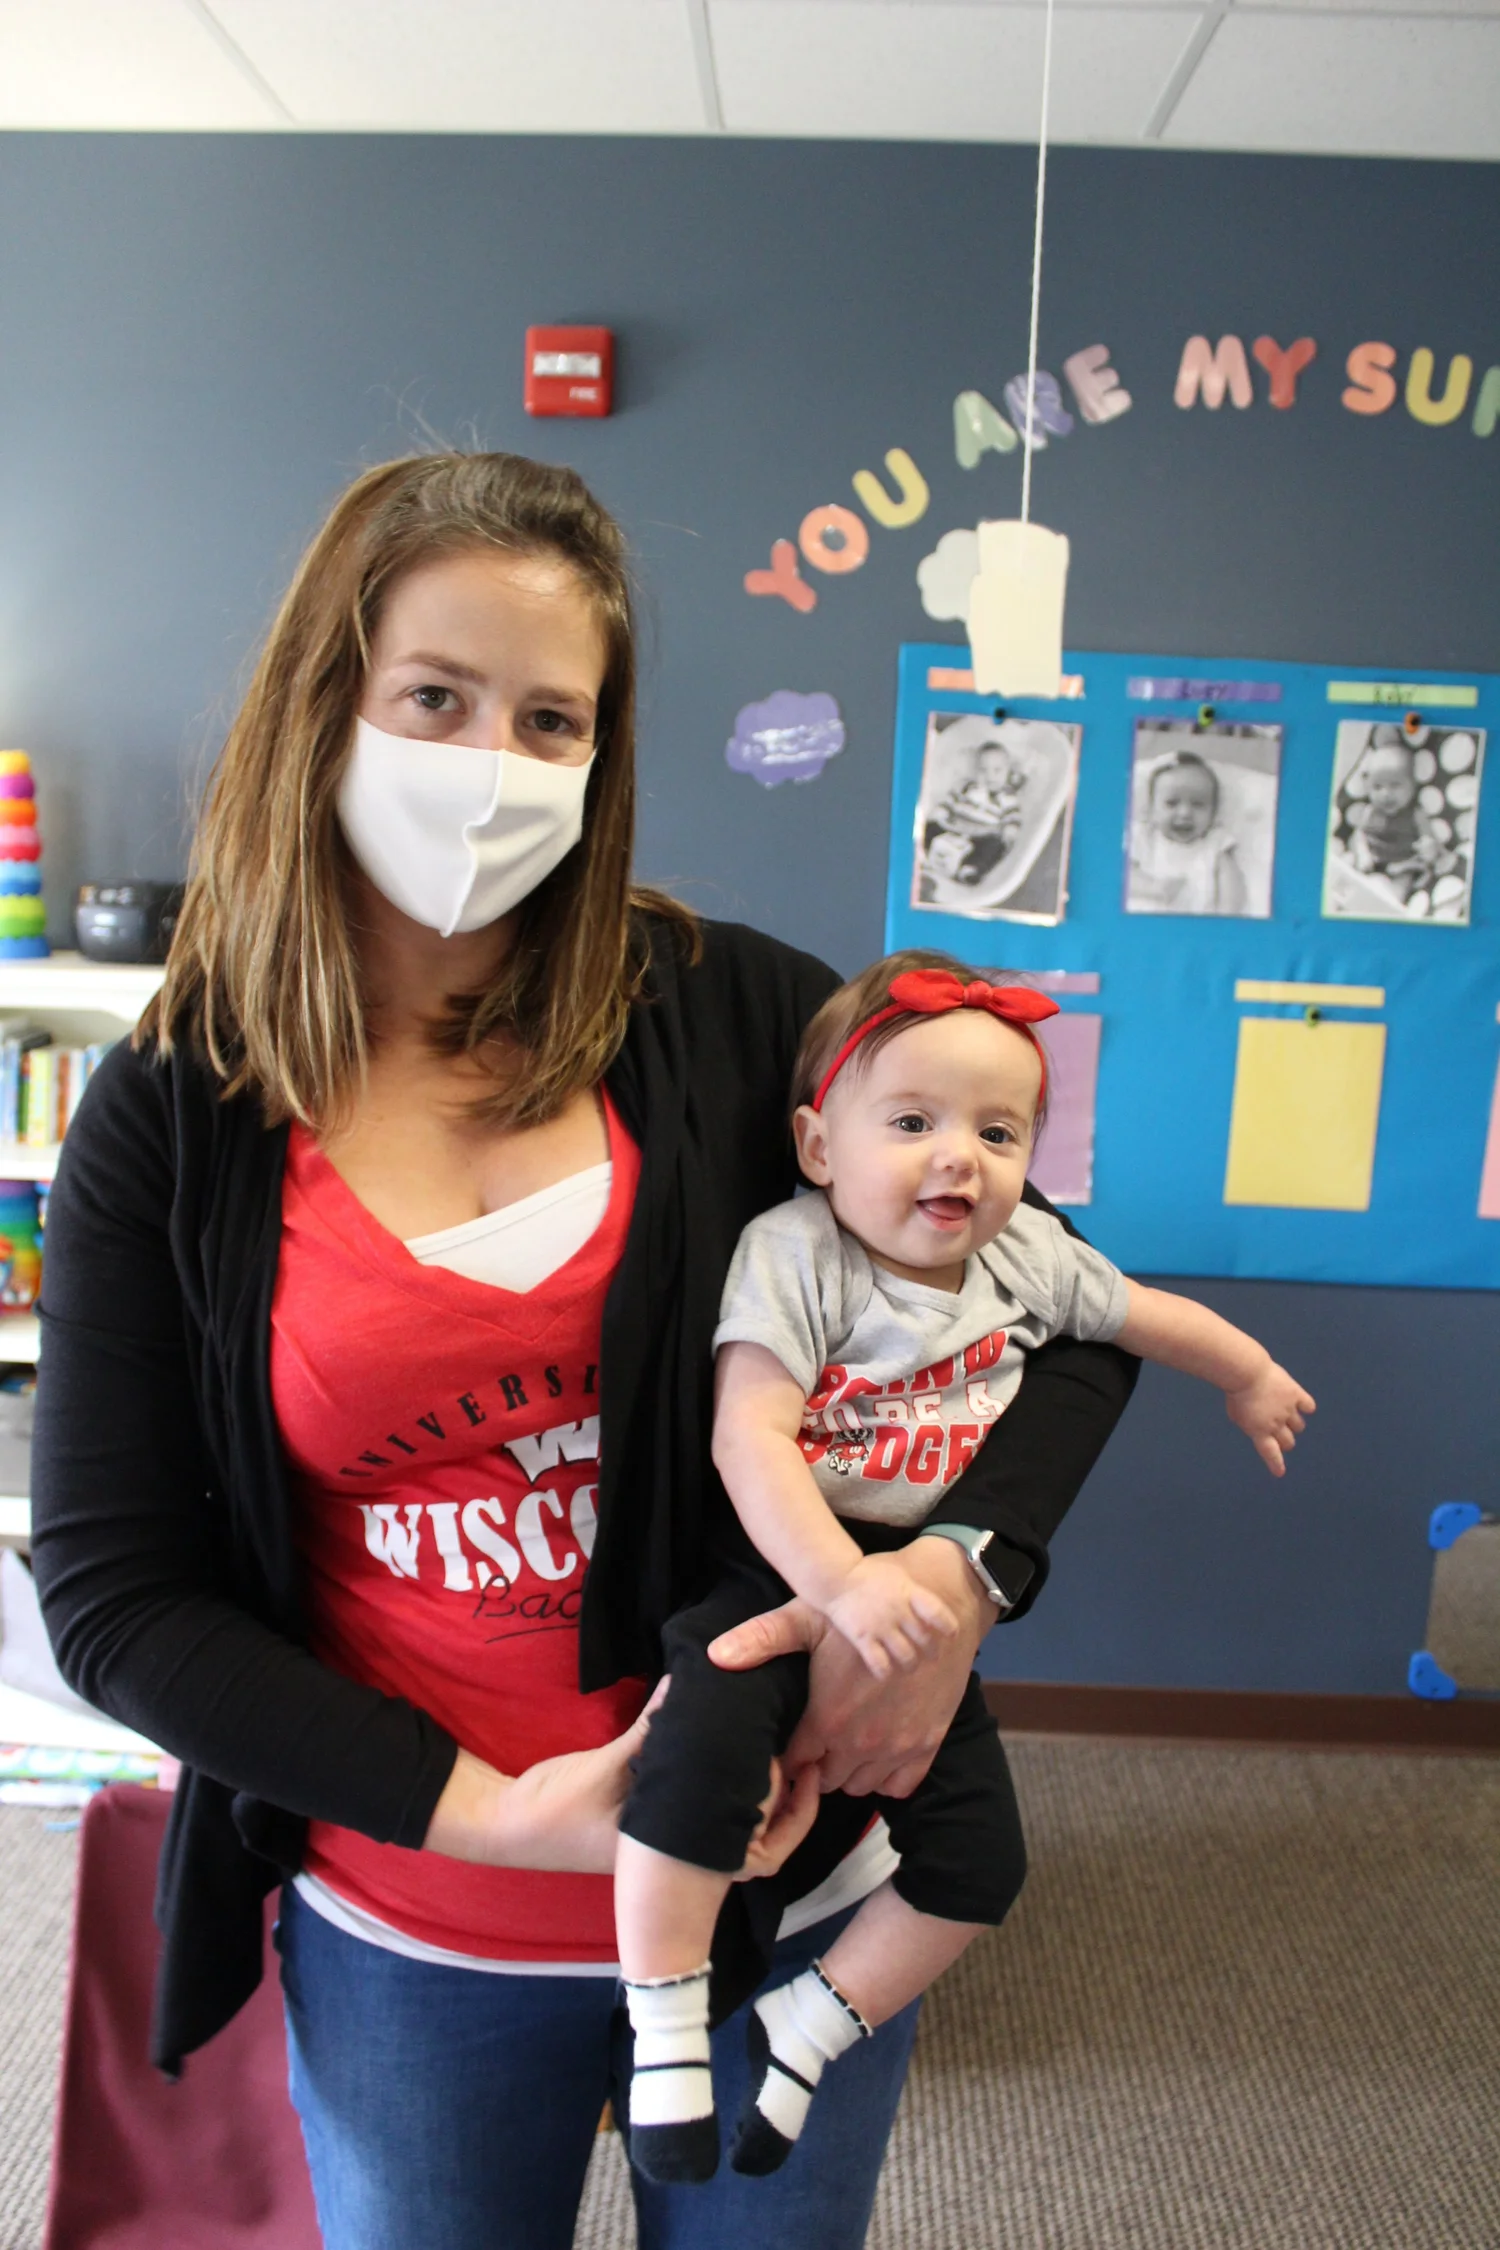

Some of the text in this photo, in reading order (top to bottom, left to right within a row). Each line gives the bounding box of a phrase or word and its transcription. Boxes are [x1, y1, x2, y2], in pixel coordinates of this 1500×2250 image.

[743, 447, 930, 613] YOU
[952, 343, 1132, 470] ARE
[1174, 335, 1317, 410] MY
